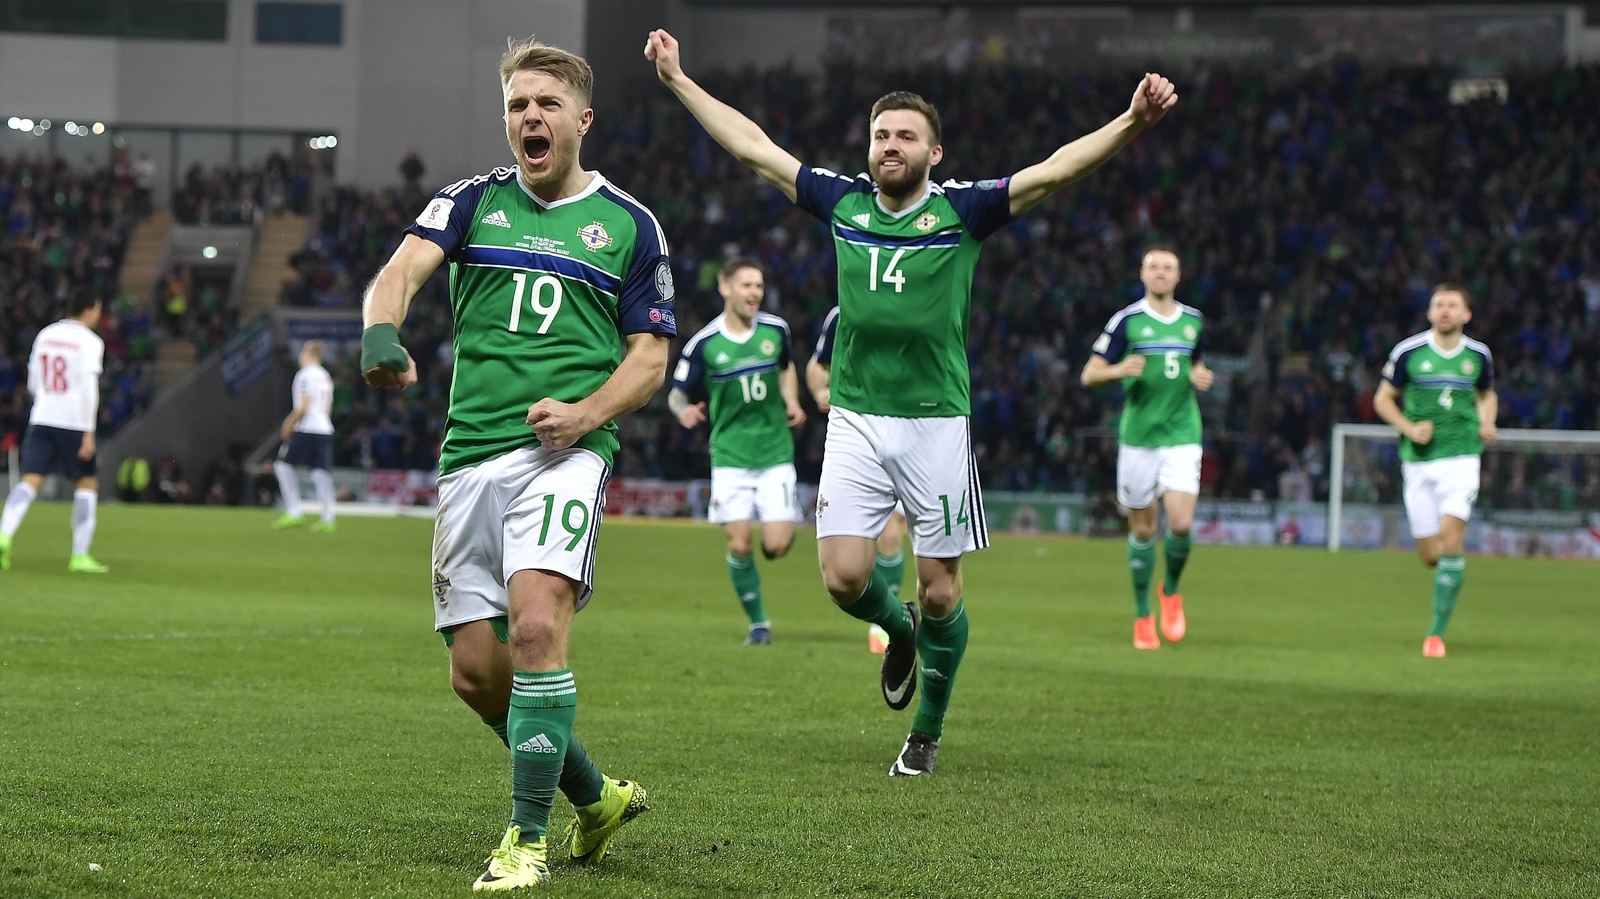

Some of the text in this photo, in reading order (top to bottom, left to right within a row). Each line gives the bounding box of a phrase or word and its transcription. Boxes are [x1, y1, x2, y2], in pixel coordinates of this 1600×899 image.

[482, 218, 511, 228] adidas
[869, 247, 906, 293] 14
[508, 273, 563, 335] 19
[41, 354, 68, 395] 18
[1164, 351, 1180, 380] 5
[738, 371, 768, 403] 16
[1437, 386, 1454, 411] 4
[537, 494, 589, 552] 19
[938, 489, 969, 536] 14
[516, 744, 558, 754] adidas
